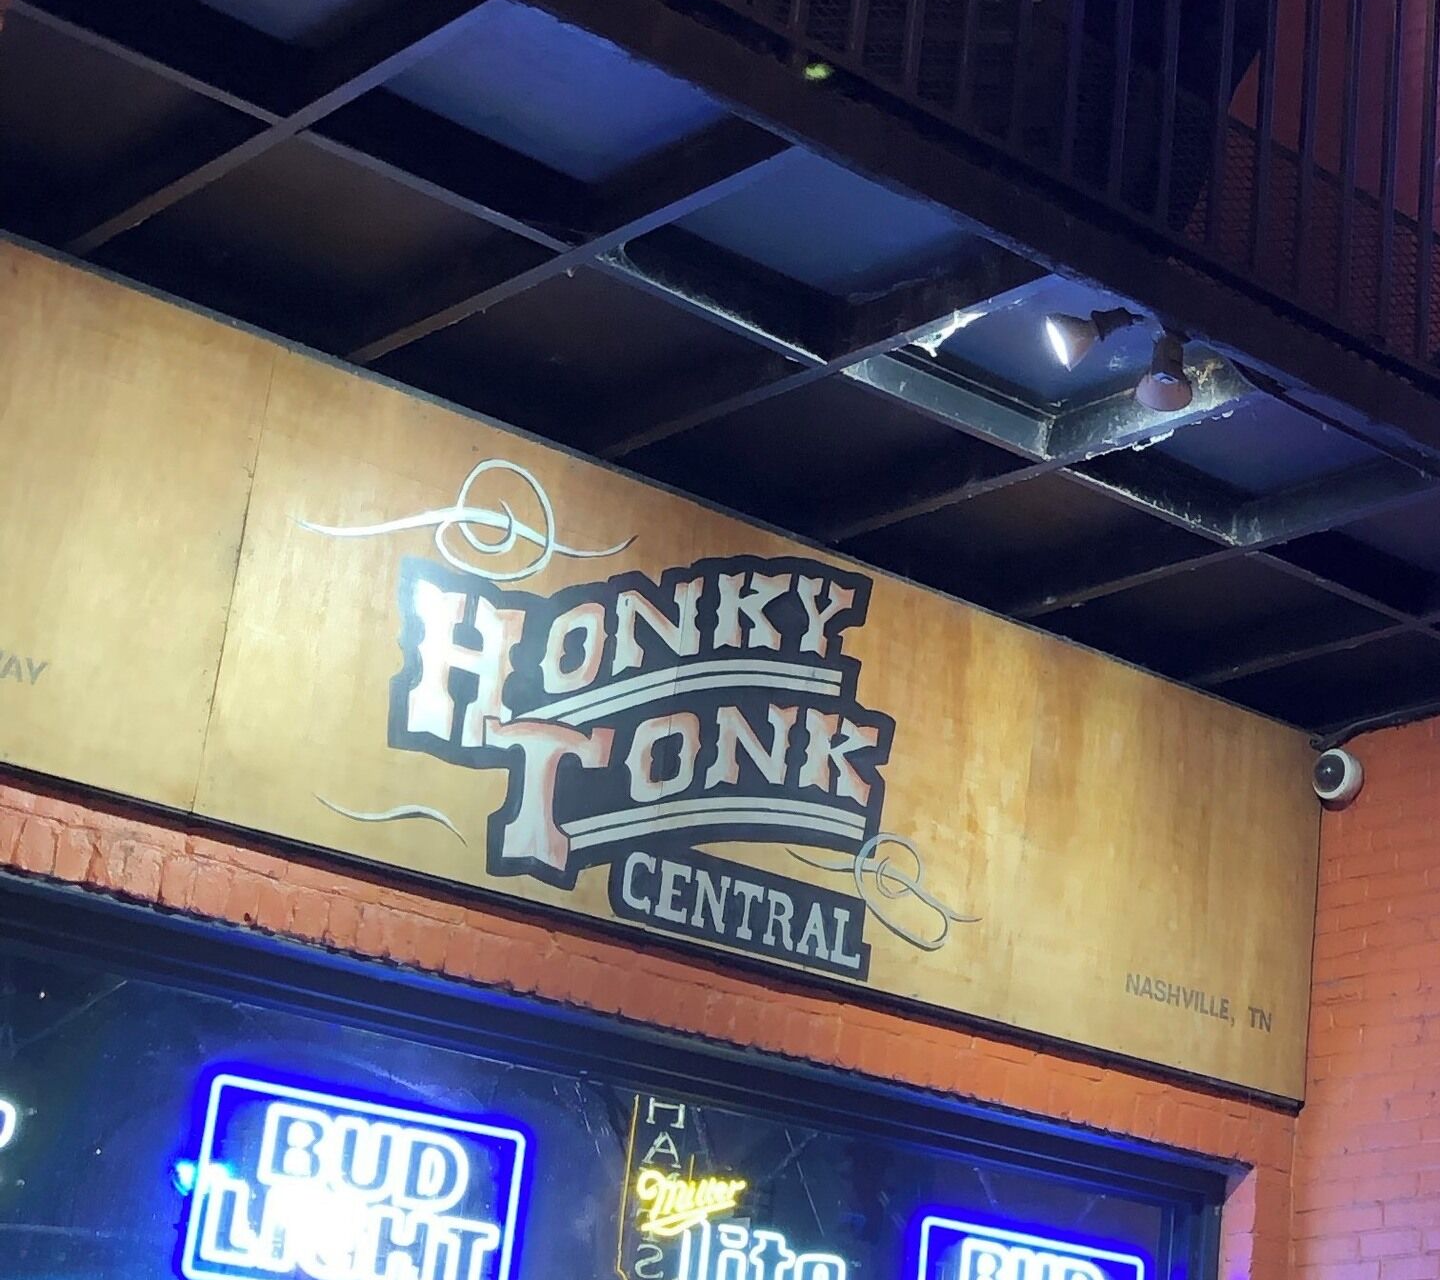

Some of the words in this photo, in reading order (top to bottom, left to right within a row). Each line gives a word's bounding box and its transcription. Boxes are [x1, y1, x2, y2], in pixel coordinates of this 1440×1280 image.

[0, 650, 48, 686] AY
[406, 572, 857, 750] HONKY
[484, 705, 878, 872] TONK
[622, 851, 862, 968] CENTRAL
[1125, 973, 1235, 1027] NASHVILLE,
[1248, 1006, 1273, 1033] TN
[257, 1102, 470, 1212] BUD
[636, 1169, 747, 1234] Miller
